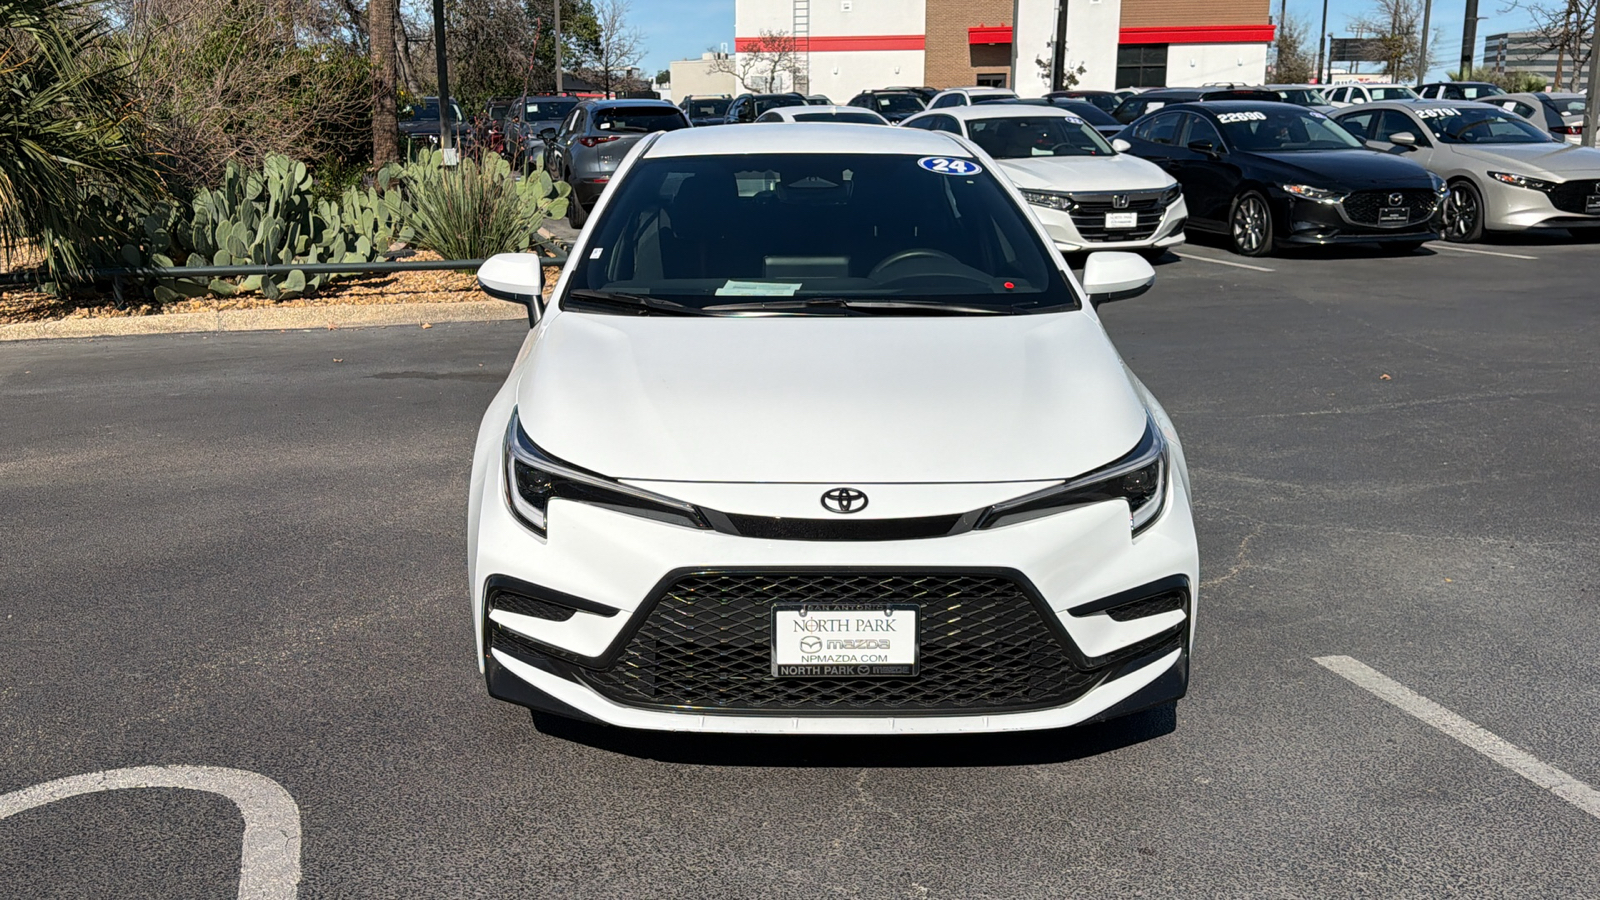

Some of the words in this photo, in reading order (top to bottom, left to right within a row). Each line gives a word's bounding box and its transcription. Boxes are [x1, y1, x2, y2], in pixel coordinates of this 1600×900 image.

[932, 158, 967, 173] 24
[793, 618, 850, 632] NORTH
[856, 618, 896, 632] PARK
[827, 639, 890, 650] mazda
[801, 654, 888, 663] NPMAZDA.COM
[781, 666, 821, 675] NORTH
[824, 666, 855, 675] PARK
